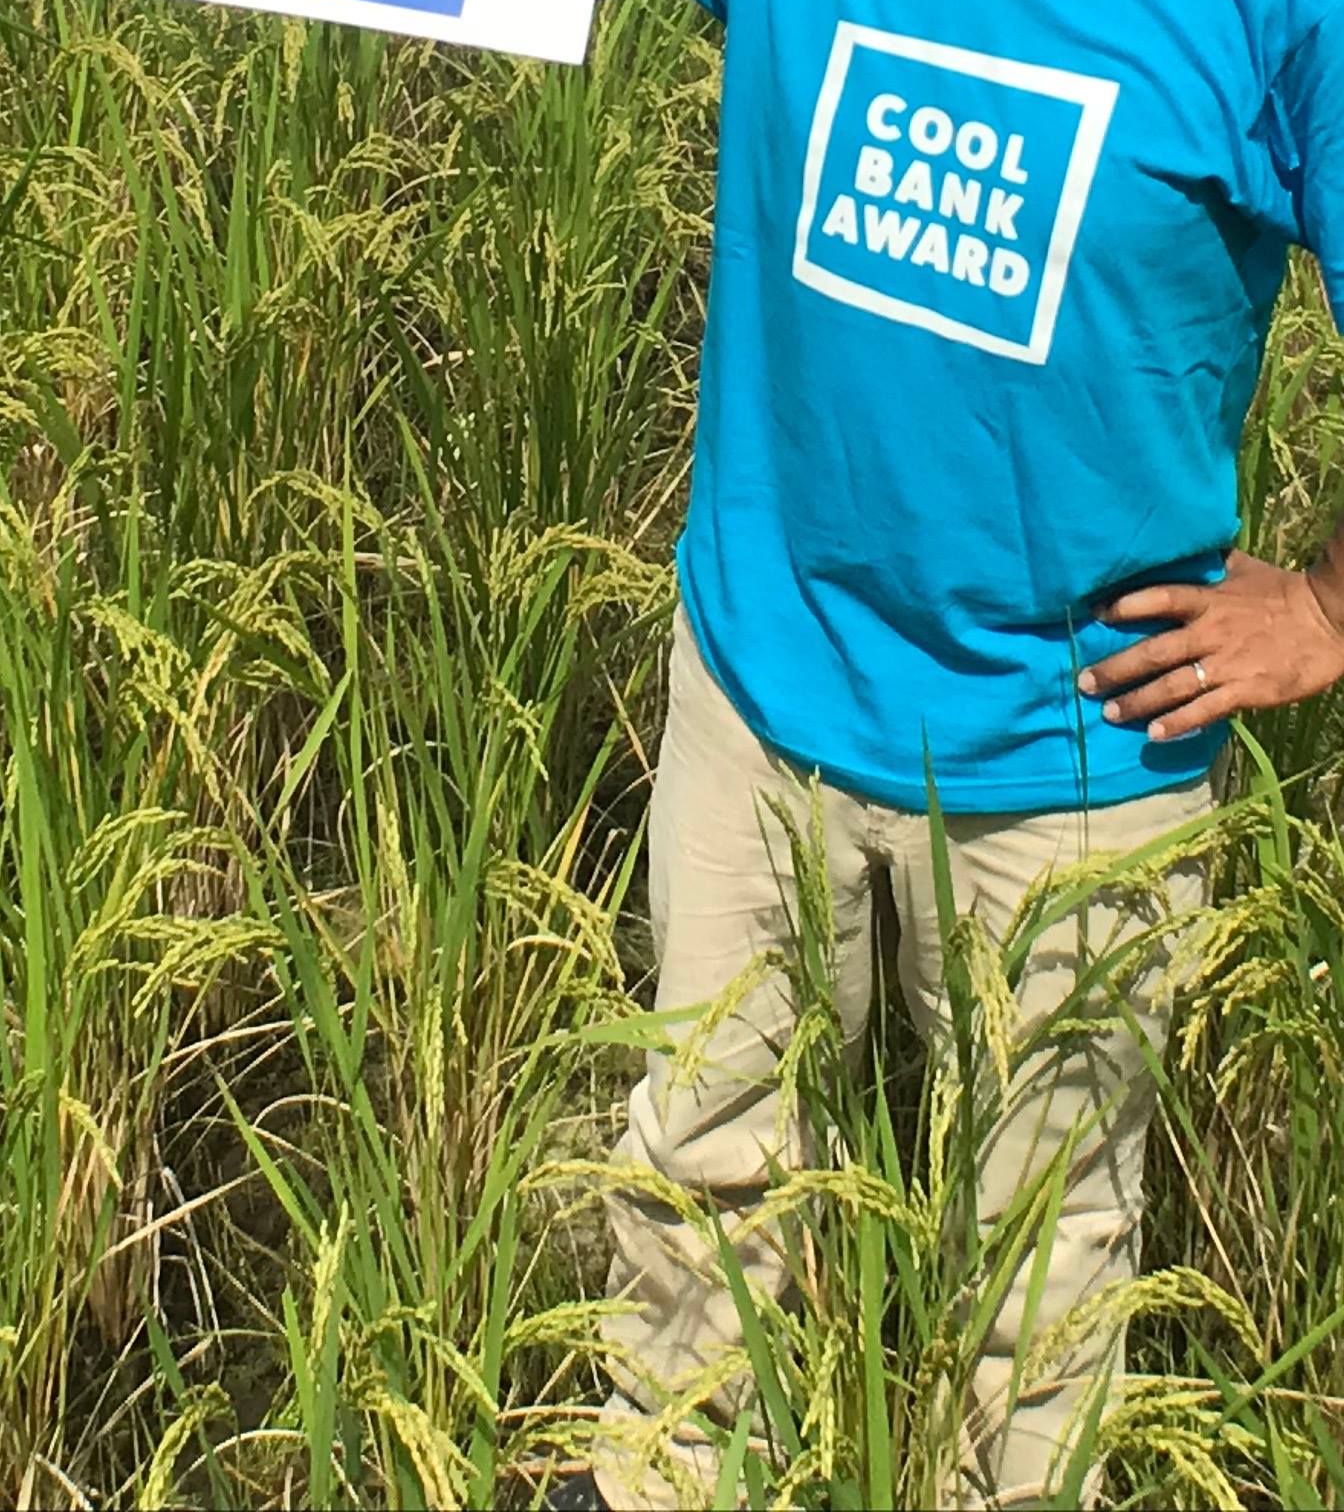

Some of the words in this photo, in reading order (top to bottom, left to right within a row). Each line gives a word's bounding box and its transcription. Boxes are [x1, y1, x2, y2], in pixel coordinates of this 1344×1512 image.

[866, 93, 1028, 184] COOL
[855, 145, 1024, 240] BANK
[822, 194, 1030, 297] AWARD
